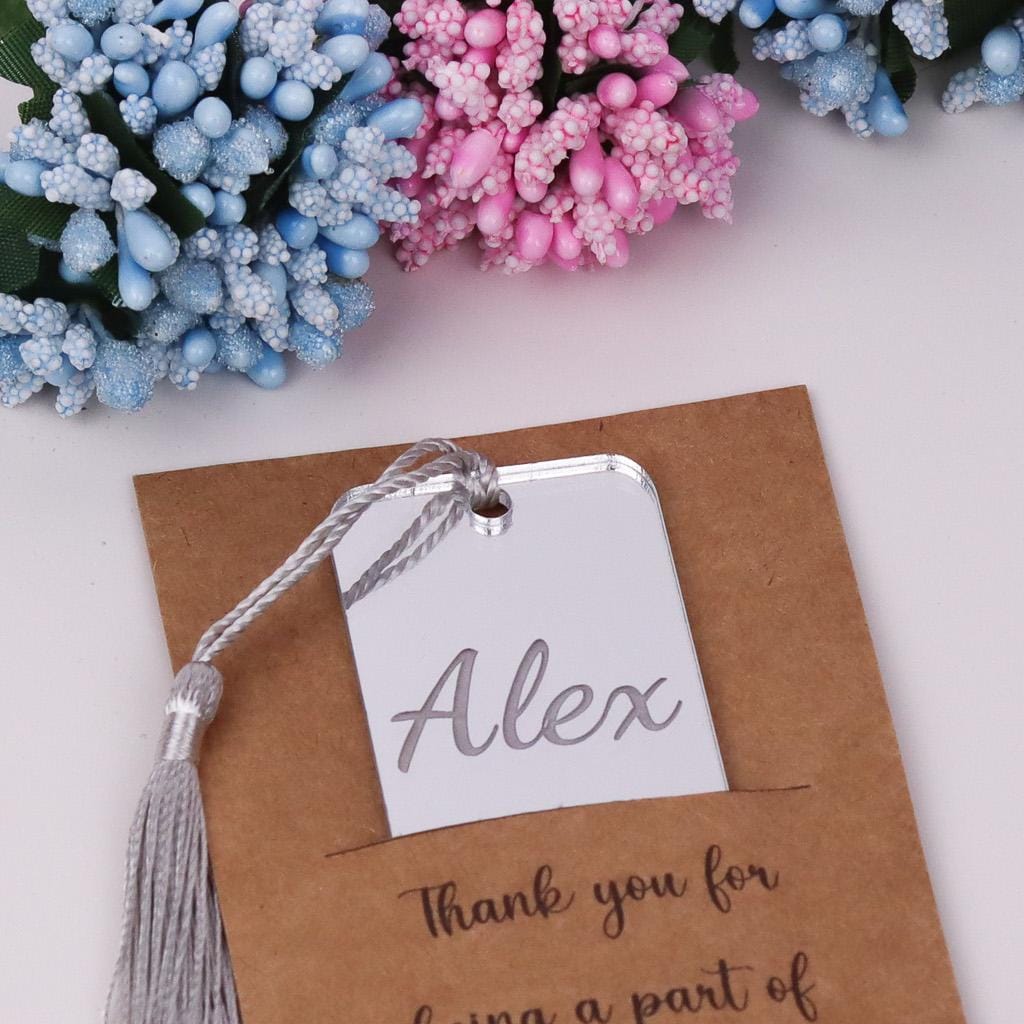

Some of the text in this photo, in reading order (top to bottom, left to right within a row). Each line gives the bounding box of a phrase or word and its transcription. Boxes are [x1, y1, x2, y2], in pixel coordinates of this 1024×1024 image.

[390, 638, 682, 772] Alex
[399, 844, 779, 939] Thank you for
[766, 951, 818, 1022] of
